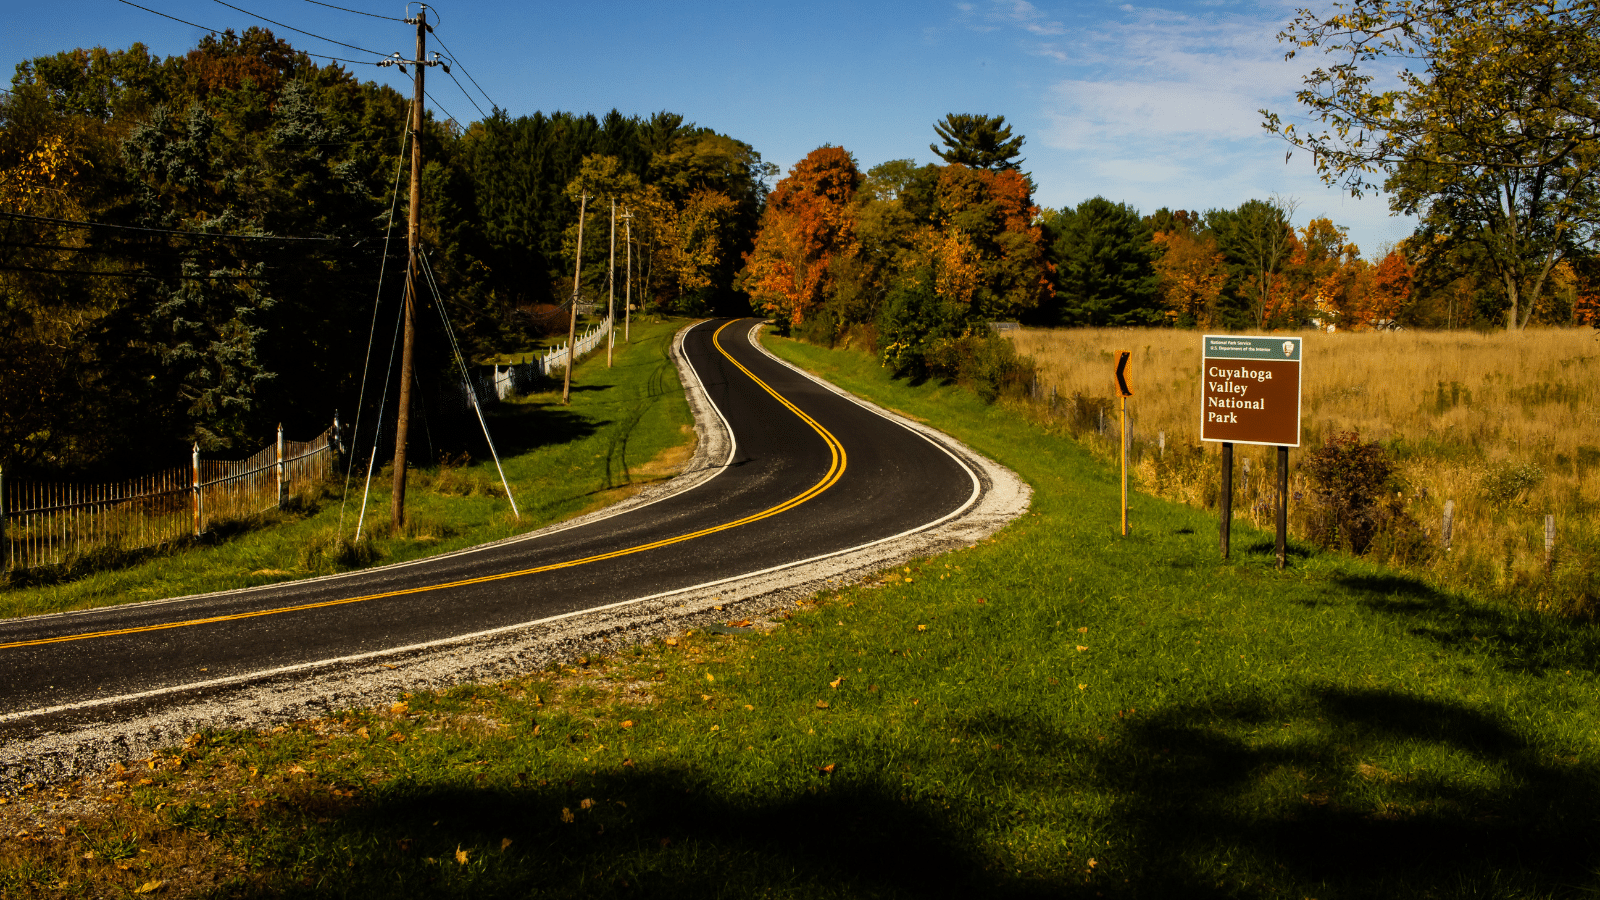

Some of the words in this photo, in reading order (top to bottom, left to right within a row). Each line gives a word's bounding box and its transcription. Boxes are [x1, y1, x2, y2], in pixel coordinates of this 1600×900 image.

[1209, 366, 1273, 382] Cuyahoga
[1208, 381, 1248, 397] Valley
[1208, 397, 1265, 410] National
[1208, 411, 1238, 424] Park
